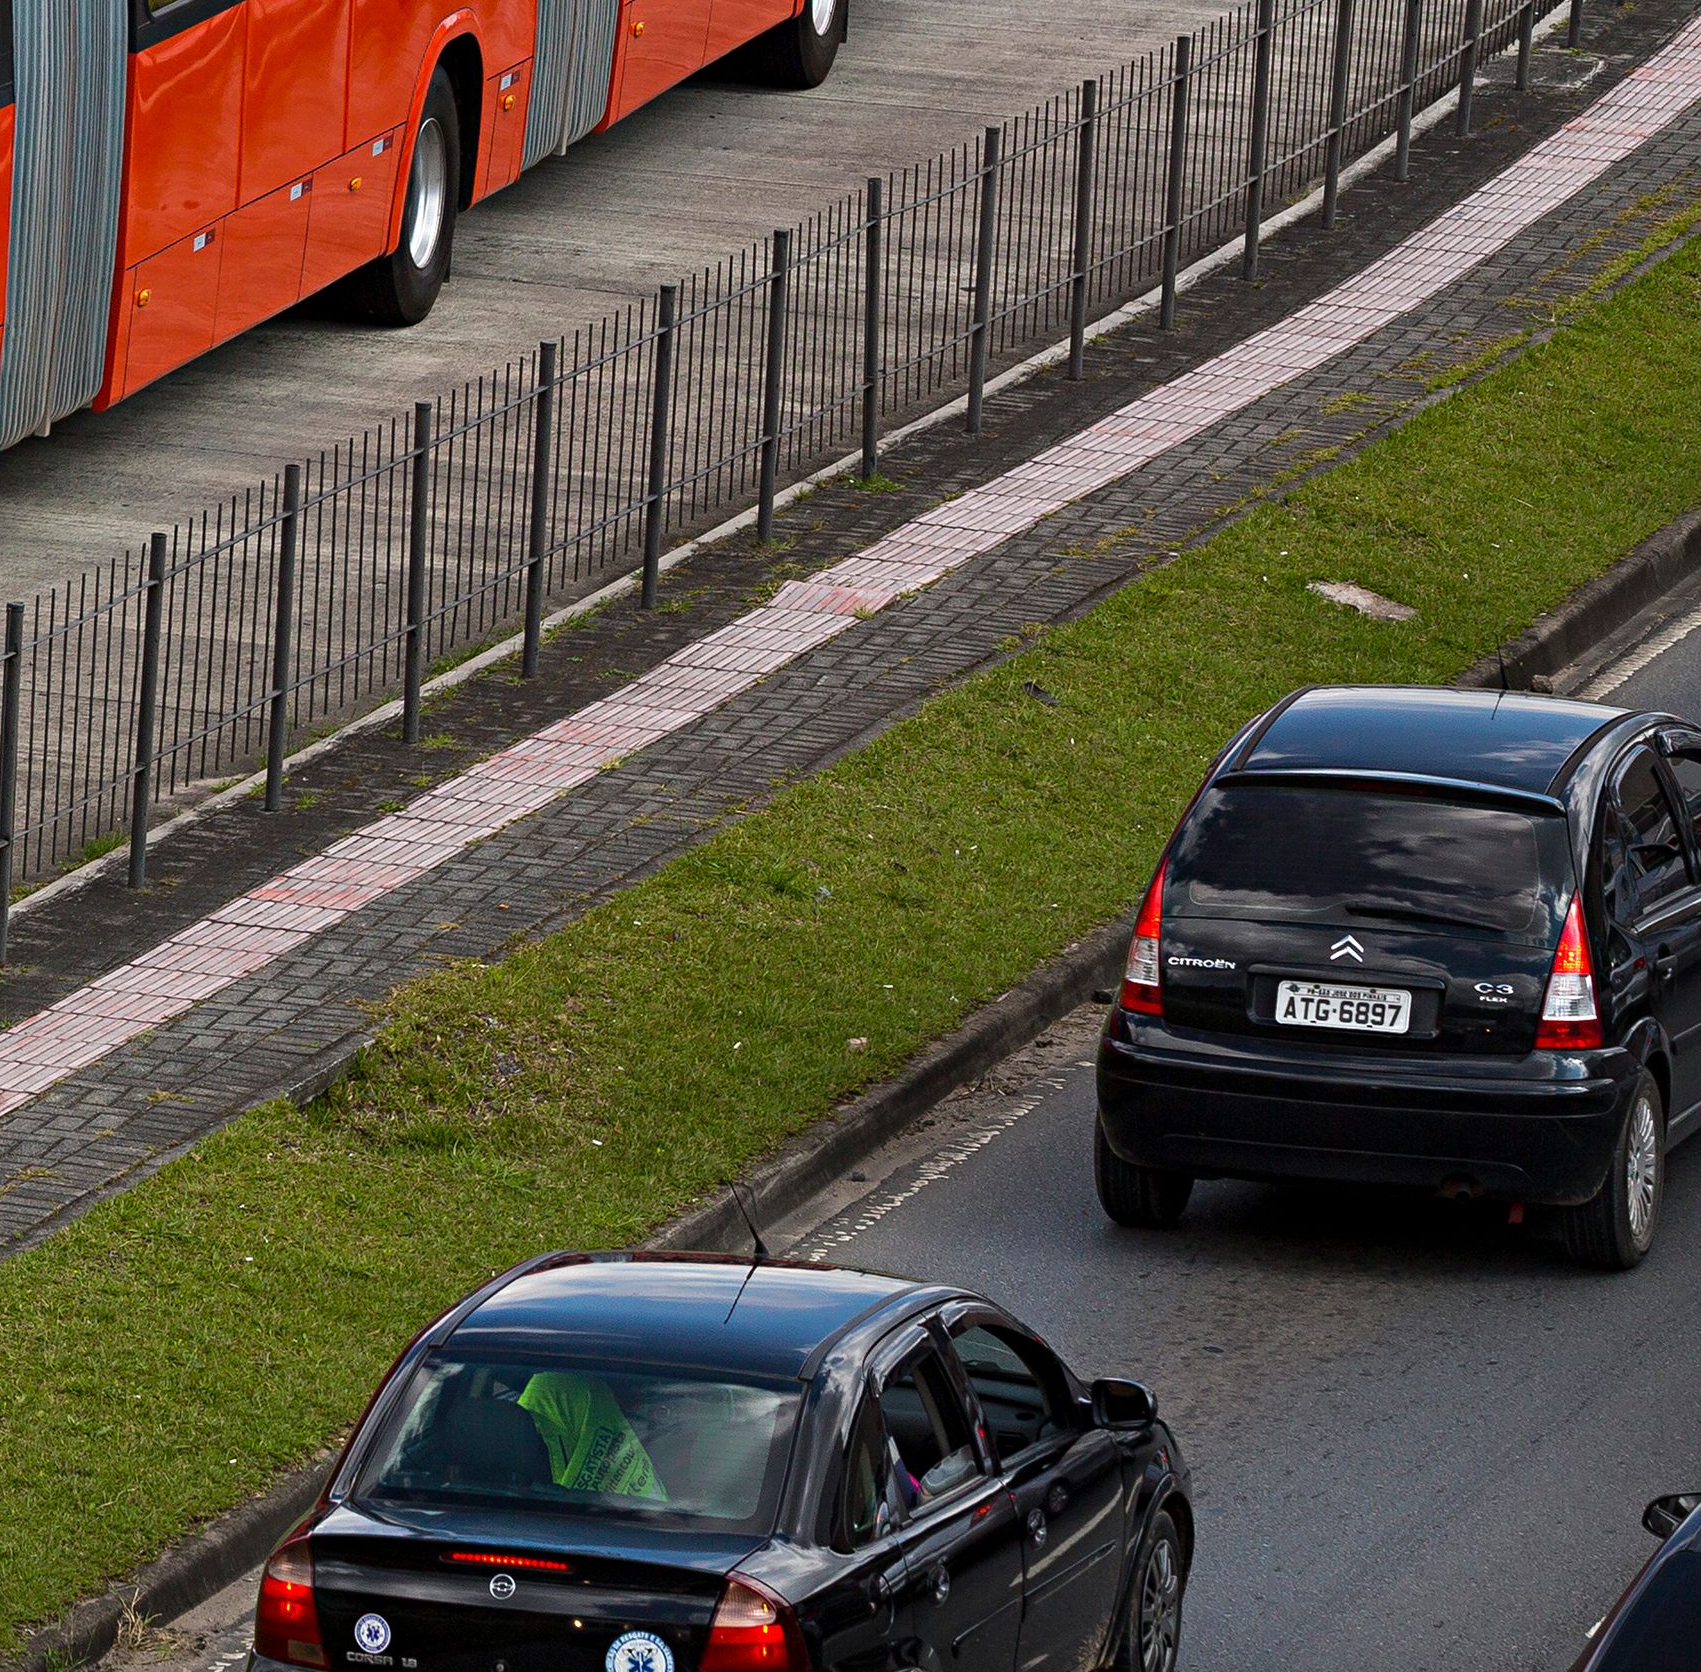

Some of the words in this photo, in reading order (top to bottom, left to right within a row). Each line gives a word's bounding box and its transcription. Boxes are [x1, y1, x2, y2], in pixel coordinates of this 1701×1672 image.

[1168, 956, 1236, 969] CITROËN
[1474, 982, 1514, 995] C3
[346, 1651, 393, 1666] CORSA
